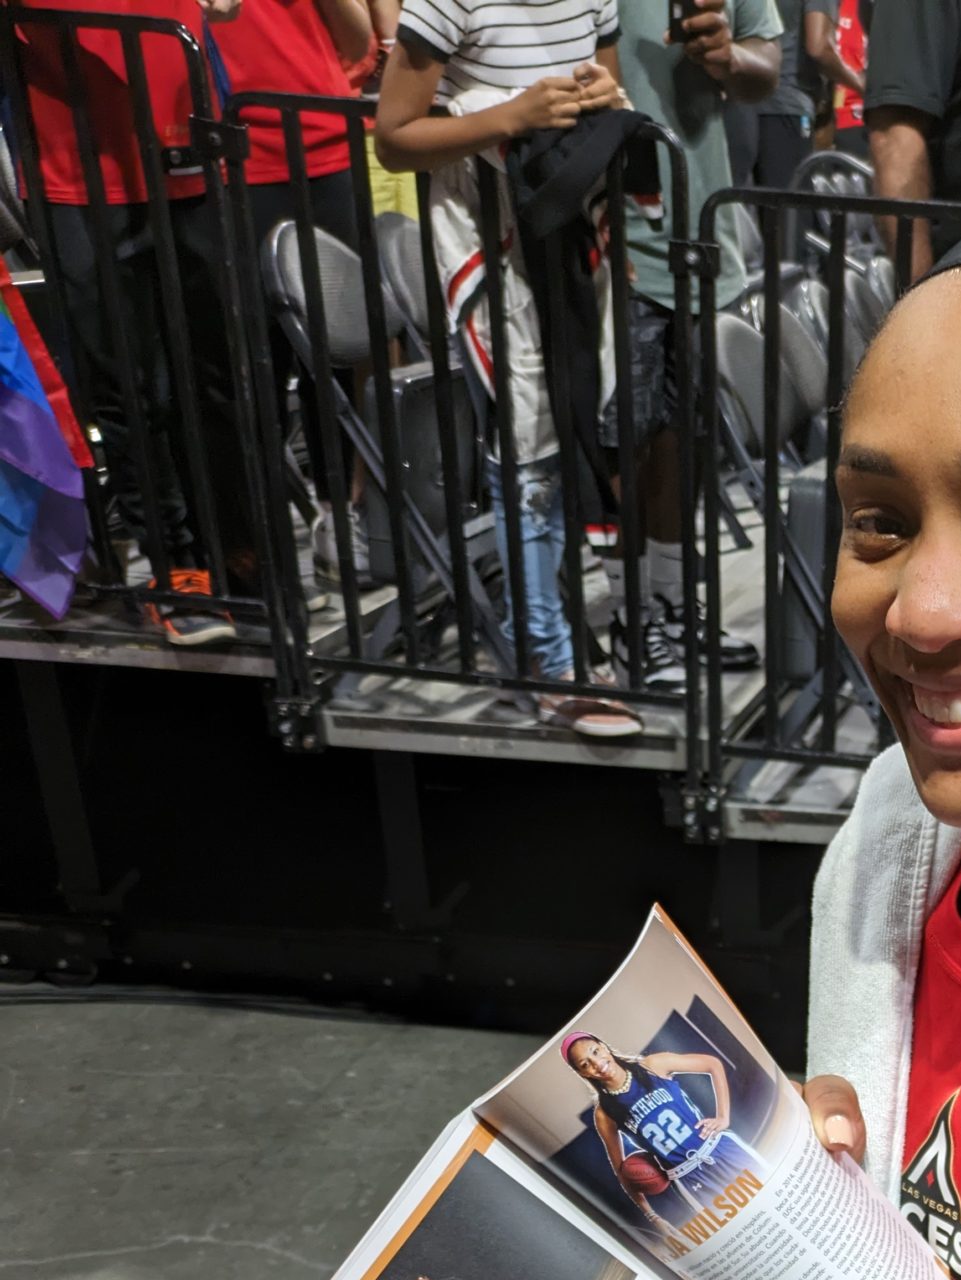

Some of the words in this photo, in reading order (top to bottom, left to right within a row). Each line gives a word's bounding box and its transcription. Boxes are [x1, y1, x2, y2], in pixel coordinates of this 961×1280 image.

[641, 1108, 694, 1157] 22
[679, 1168, 764, 1247] WILSON
[902, 1182, 921, 1199] LAS
[922, 1195, 959, 1221] VEGAS
